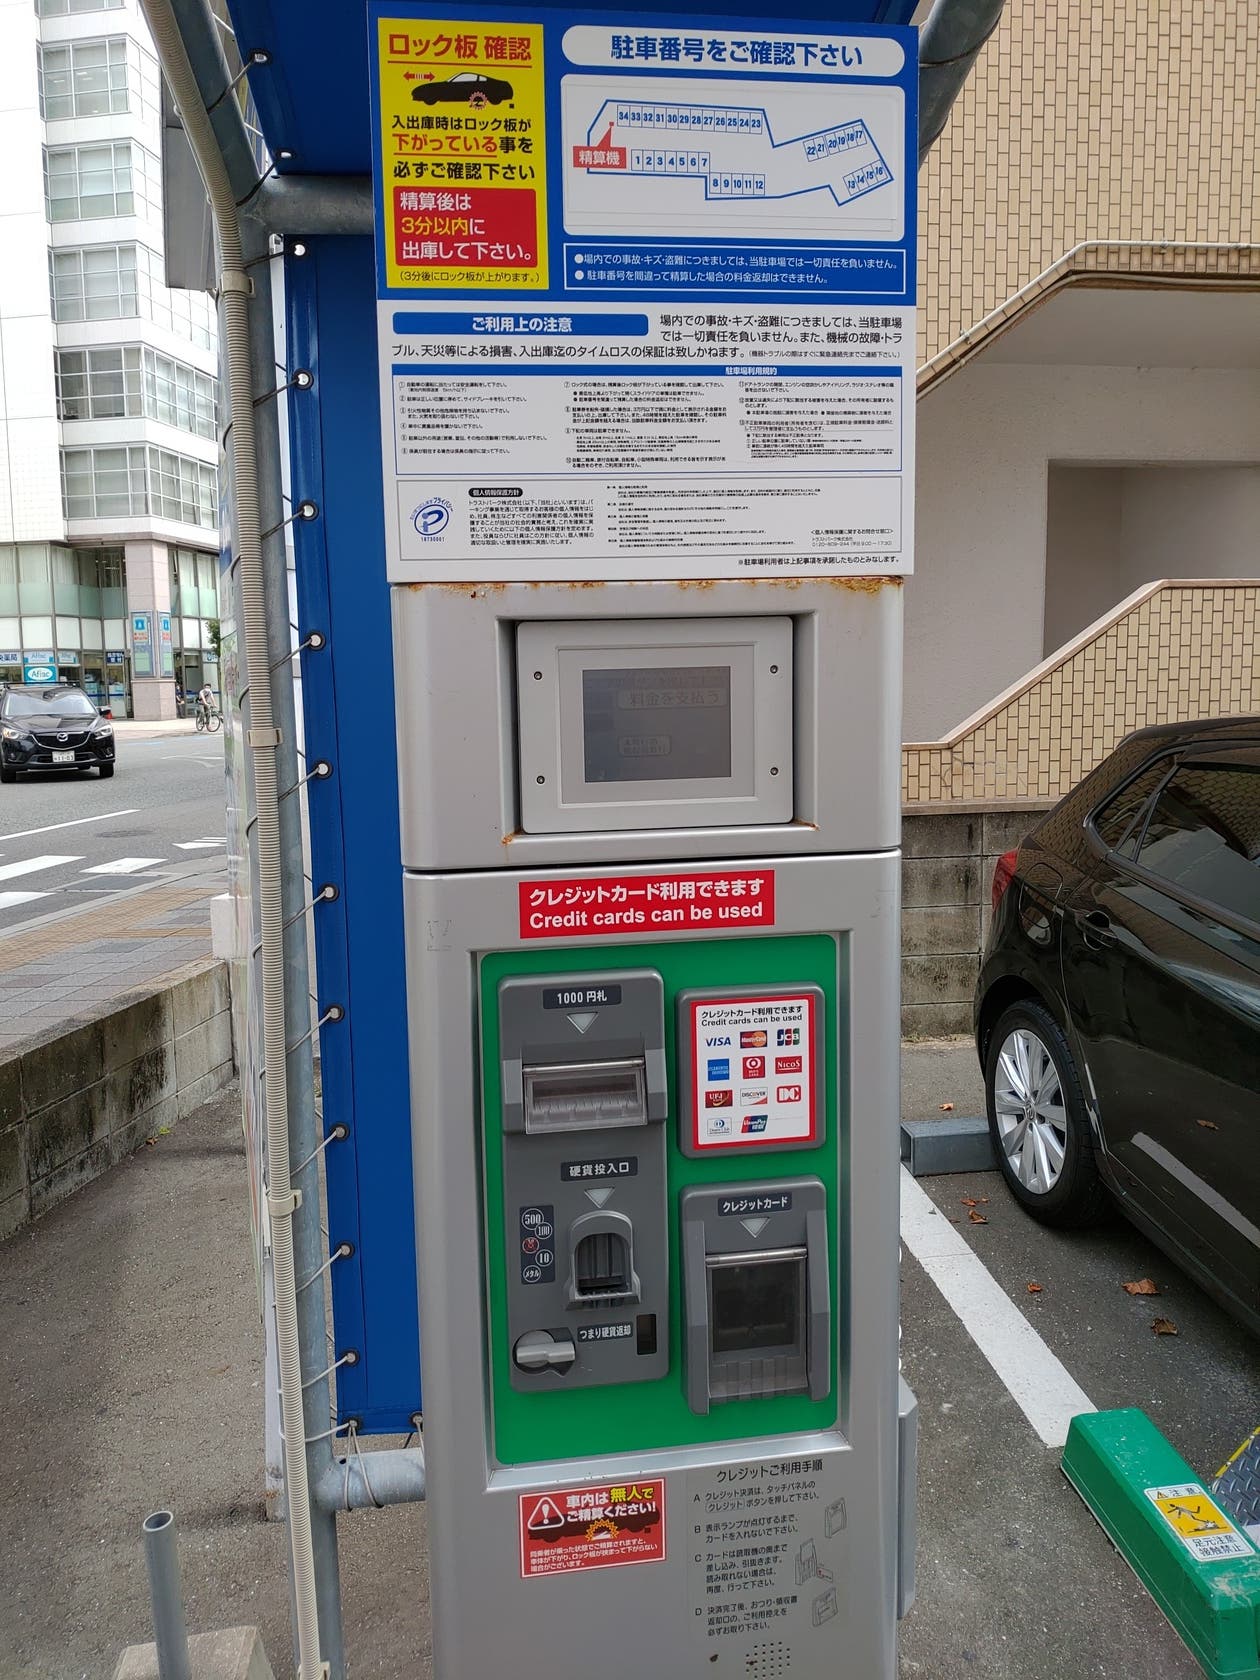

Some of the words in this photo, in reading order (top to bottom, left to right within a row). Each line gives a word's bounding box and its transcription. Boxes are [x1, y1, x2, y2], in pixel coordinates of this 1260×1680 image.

[389, 34, 477, 59] ロック板
[484, 35, 532, 61] 確認
[611, 34, 862, 67] 駐車番号をご確認下さい
[392, 115, 531, 132] 入出庫時はロック板が
[619, 112, 629, 121] 34
[631, 112, 641, 121] 33
[643, 113, 653, 122] 32
[656, 113, 664, 122] 31
[668, 114, 677, 123] 30
[680, 115, 689, 124] 29
[692, 115, 701, 124] 28
[704, 116, 713, 125] 27
[715, 117, 725, 126] 26
[728, 118, 737, 126] 25
[740, 118, 749, 127] 24
[751, 119, 761, 128] 23
[392, 133, 532, 154] 下がっている事を
[807, 146, 816, 155] 22
[817, 144, 825, 152] 21
[828, 140, 837, 148] 20
[838, 136, 845, 145] 19
[847, 133, 854, 141] 18
[856, 131, 863, 139] 17
[579, 150, 620, 166] 精算機
[393, 160, 535, 181] 必ずご確認下さい
[848, 180, 856, 189] 13
[857, 175, 864, 183] 14
[866, 171, 874, 179] 15
[875, 167, 883, 175] 16
[712, 178, 718, 187] 8
[723, 179, 729, 188] 9
[734, 179, 741, 188] 10
[745, 180, 751, 189] 11
[756, 180, 763, 189] 12
[400, 191, 472, 212] 精算後は
[401, 216, 485, 236] 3分以内に
[402, 240, 531, 261] 出庫して下さい。
[472, 316, 573, 333] ご利用上の注意
[660, 331, 903, 344] では一切責任を負いません。また、機械の故障・トラ
[725, 366, 777, 376] 駐車場利用規約
[31, 670, 50, 678] Aflac
[529, 878, 765, 907] クレジットカード利用できます
[529, 910, 588, 929] Credit
[593, 908, 646, 925] cards
[651, 906, 684, 921] can
[690, 903, 712, 920] be
[718, 901, 763, 919] used
[556, 991, 583, 1005] 1000
[586, 990, 607, 1003] 円札
[701, 1005, 803, 1018] クレジットカード利用できます
[701, 1019, 726, 1027] Credit
[728, 1017, 751, 1025] cards
[782, 1014, 802, 1022] used
[705, 1037, 732, 1047] VISA
[779, 1086, 799, 1101] DC
[569, 1161, 629, 1177] 硬貨投入口
[722, 1196, 788, 1212] クレジットカード
[524, 1214, 541, 1225] 500
[538, 1226, 550, 1236] 100
[540, 1252, 550, 1263] 10
[525, 1270, 540, 1278] メタル
[579, 1325, 632, 1340] つまり硬貨返却
[716, 1459, 823, 1483] クレジットご利用手順
[566, 1486, 654, 1508] 車内は無人で
[693, 1494, 700, 1503] A
[694, 1525, 701, 1534] B
[694, 1554, 702, 1562] C
[695, 1608, 702, 1616] D
